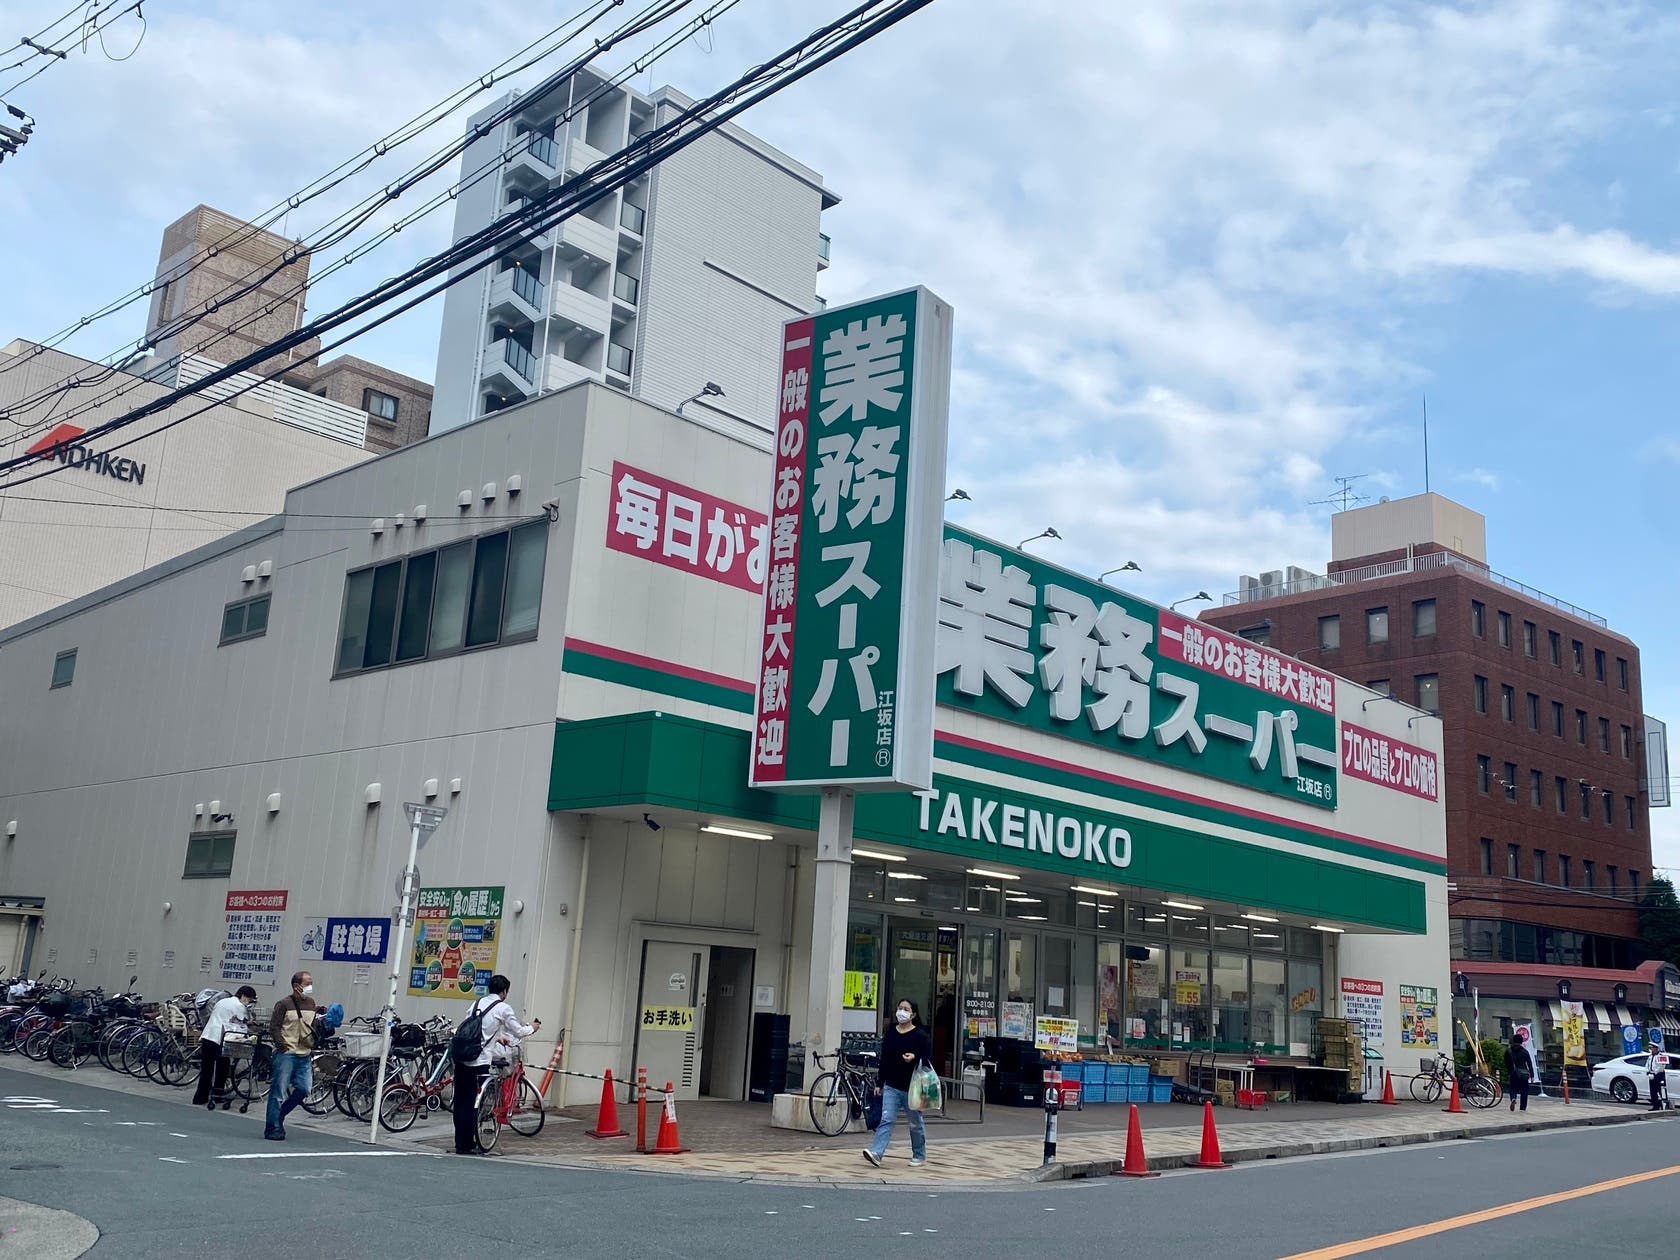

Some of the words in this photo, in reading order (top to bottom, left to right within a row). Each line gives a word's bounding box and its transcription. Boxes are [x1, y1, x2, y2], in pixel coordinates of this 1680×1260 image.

[54, 440, 146, 485] NOHKEN
[757, 336, 810, 767] 一般のお客様大歓迎
[807, 313, 907, 767] 業務スーパー
[936, 537, 1336, 779] 業務スーパー
[1160, 624, 1333, 714] 一般のお客様大歓迎
[875, 690, 894, 746] 江坂店
[1296, 776, 1323, 798] 江坂店
[1344, 729, 1436, 797] プロの品質とプロの価格
[912, 787, 1132, 868] TAKENOKO
[329, 924, 382, 955] 駐輪場
[643, 1009, 692, 1026] お手洗い
